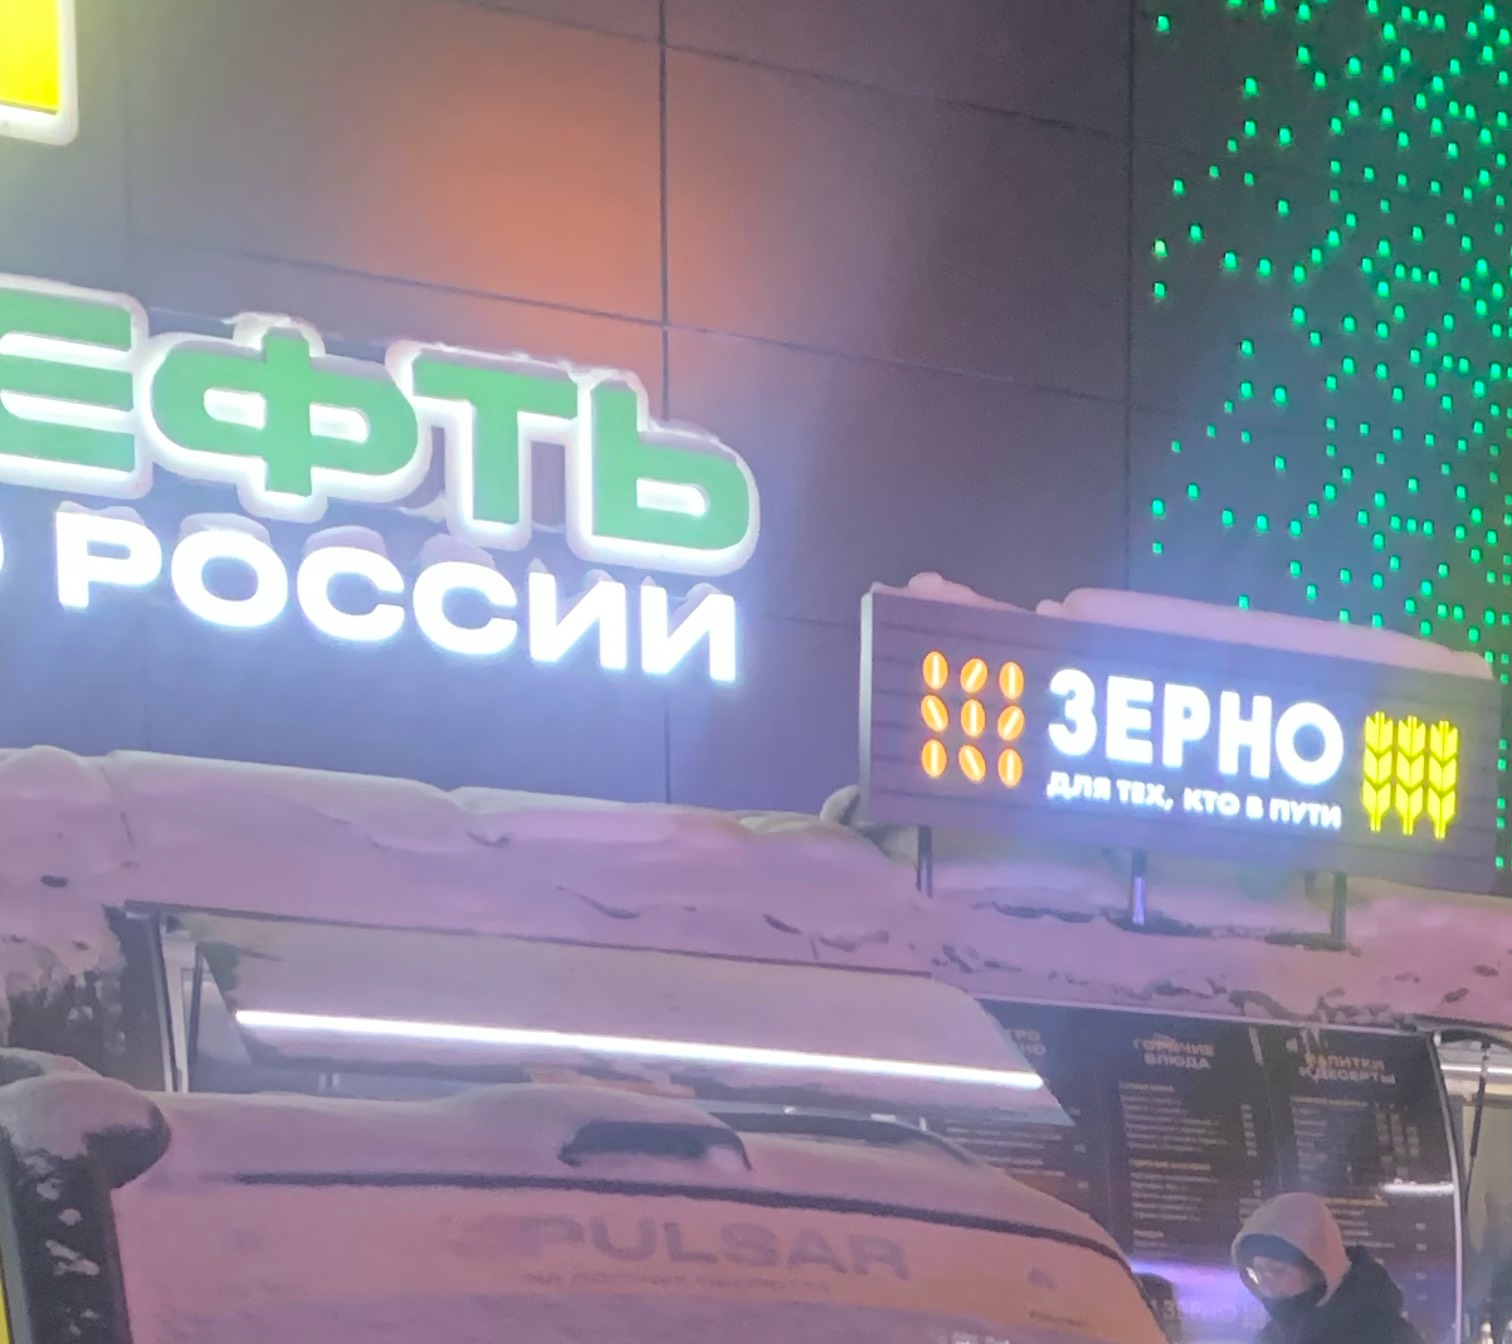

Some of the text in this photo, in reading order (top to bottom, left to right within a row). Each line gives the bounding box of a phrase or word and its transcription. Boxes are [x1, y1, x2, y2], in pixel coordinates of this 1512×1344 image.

[55, 510, 738, 683] РОССИИ
[1047, 669, 1344, 786] ЗЕРНО
[1046, 771, 1342, 830] ДЛЯ ТЕХ, КТО В ПУТИ
[519, 1214, 911, 1281] PULSAR
